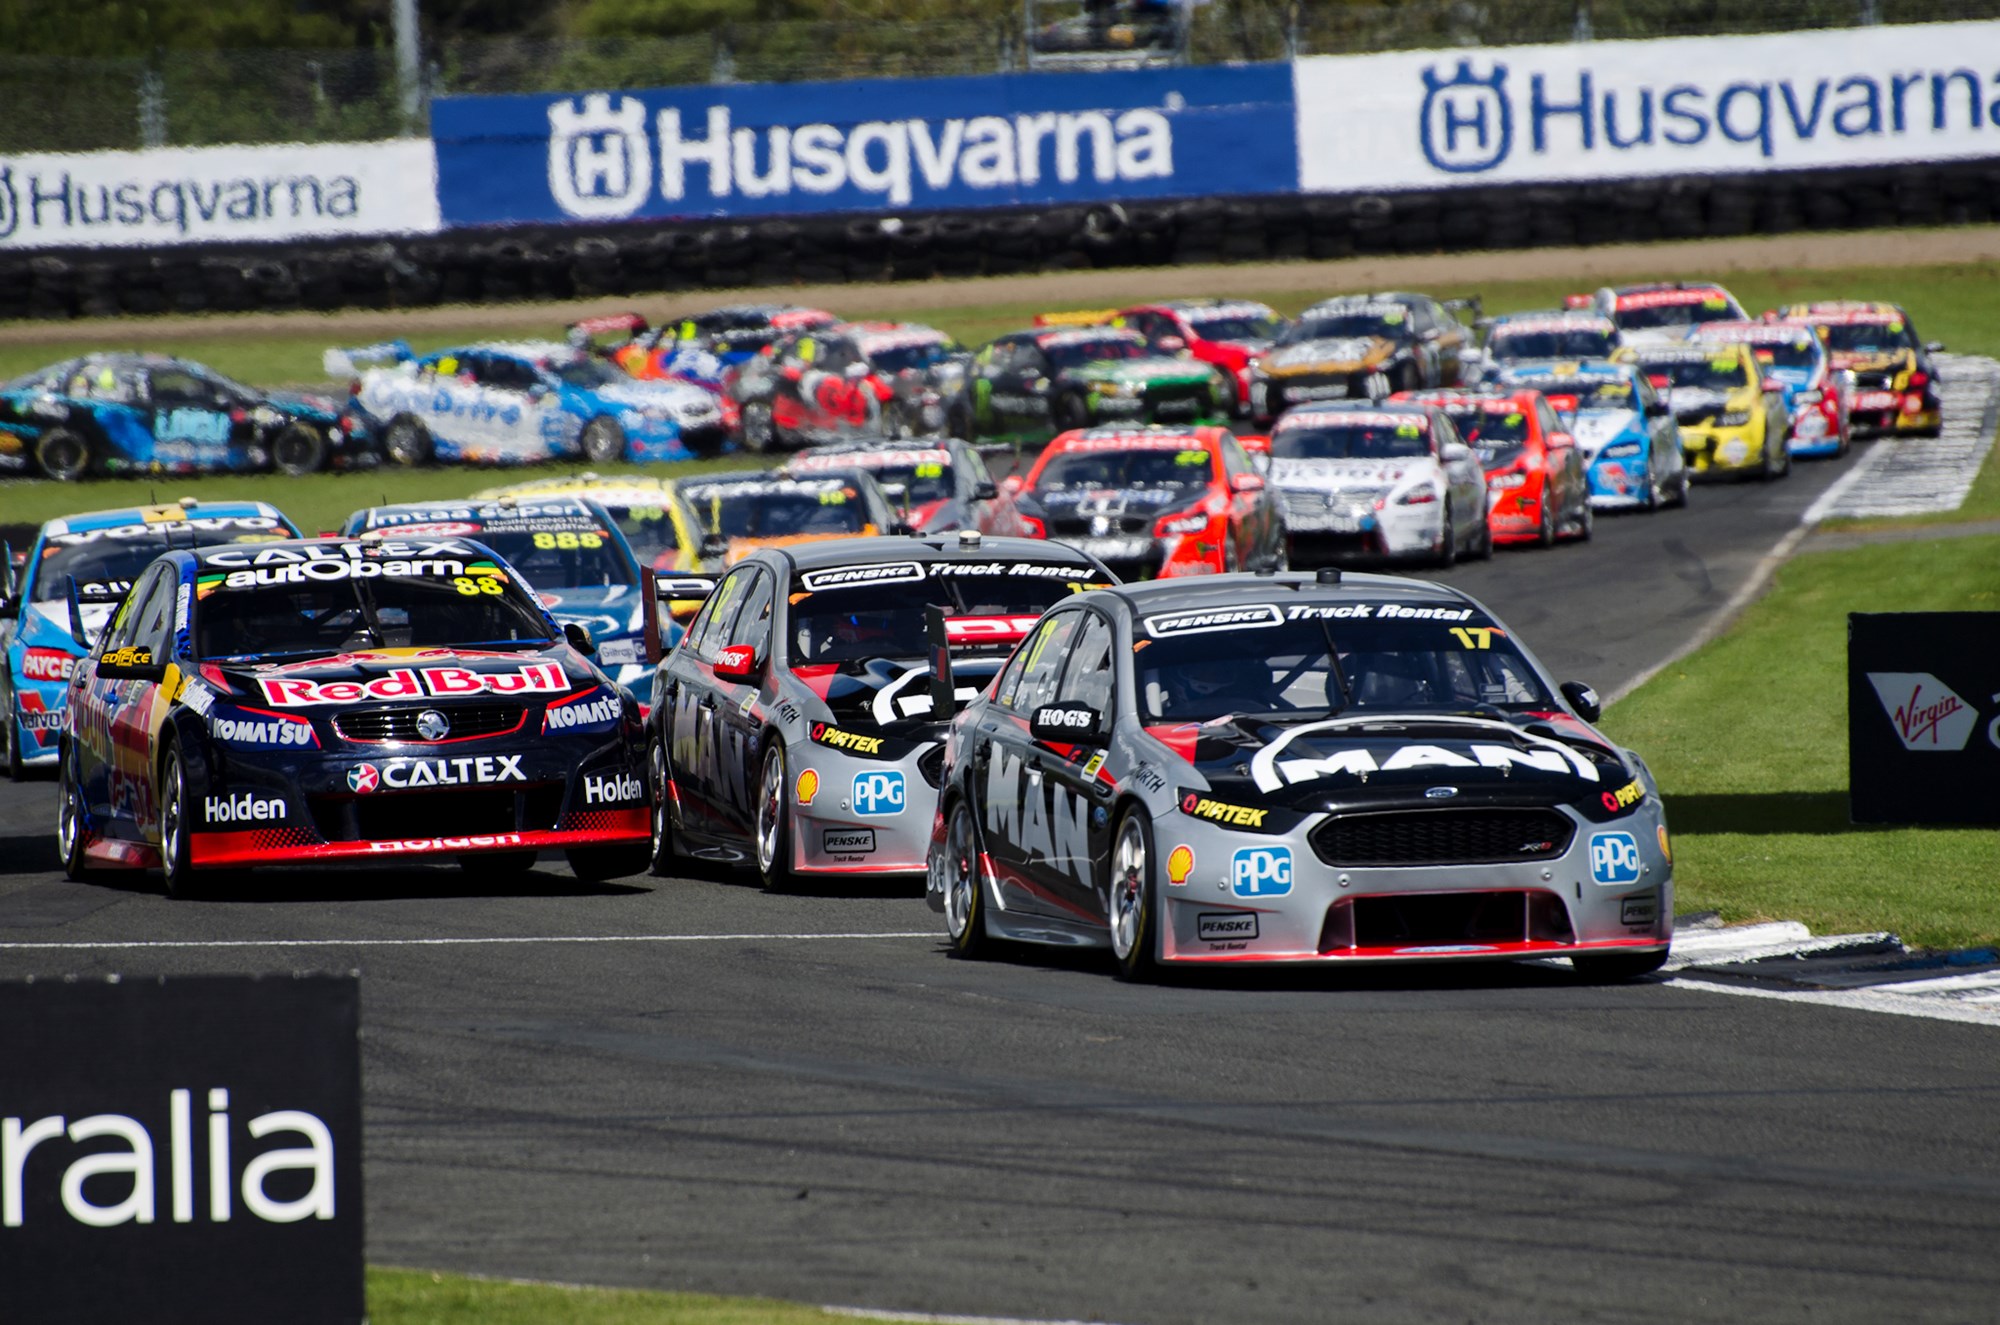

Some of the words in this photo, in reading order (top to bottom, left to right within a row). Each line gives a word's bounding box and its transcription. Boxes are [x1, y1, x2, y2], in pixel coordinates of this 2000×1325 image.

[1530, 66, 2000, 158] Husqvarn
[657, 104, 1173, 206] Husqvarna
[27, 171, 361, 232] Husqvarna
[50, 517, 278, 543] VOLVO
[377, 509, 471, 525] mtaa
[206, 539, 472, 568] CALTEX
[532, 530, 604, 550] 888
[453, 575, 504, 597] 88
[813, 566, 912, 585] PENSKE
[929, 563, 1001, 576] Truck
[1007, 563, 1096, 580] Rental
[1157, 608, 1271, 631] PENSKE
[1287, 605, 1372, 621] Truck
[1376, 605, 1474, 622] Rental
[1448, 627, 1491, 649] 17
[22, 653, 74, 679] PAYCE
[101, 647, 151, 667] EDIFICE
[256, 667, 425, 707] Red
[419, 661, 572, 697] Bull
[545, 695, 620, 730] KOMATS
[1038, 708, 1092, 728] HOGS
[1894, 684, 1963, 744] Virgin
[212, 717, 313, 745] KOMATSU
[820, 727, 884, 755] PIRTEK
[673, 683, 748, 812] MAN
[381, 754, 527, 788] CALTEX
[1274, 744, 1572, 785] MAN
[583, 772, 642, 804] Holden
[854, 774, 905, 812] PPG
[205, 792, 286, 823] Holden
[986, 741, 1093, 890] MAN
[1195, 797, 1268, 828] PIRTEK
[826, 834, 871, 847] PENSKE
[1234, 851, 1291, 893] PPG
[1592, 837, 1639, 880] PPG
[1201, 920, 1253, 933] PENSKE
[1, 1087, 335, 1227] ralia
